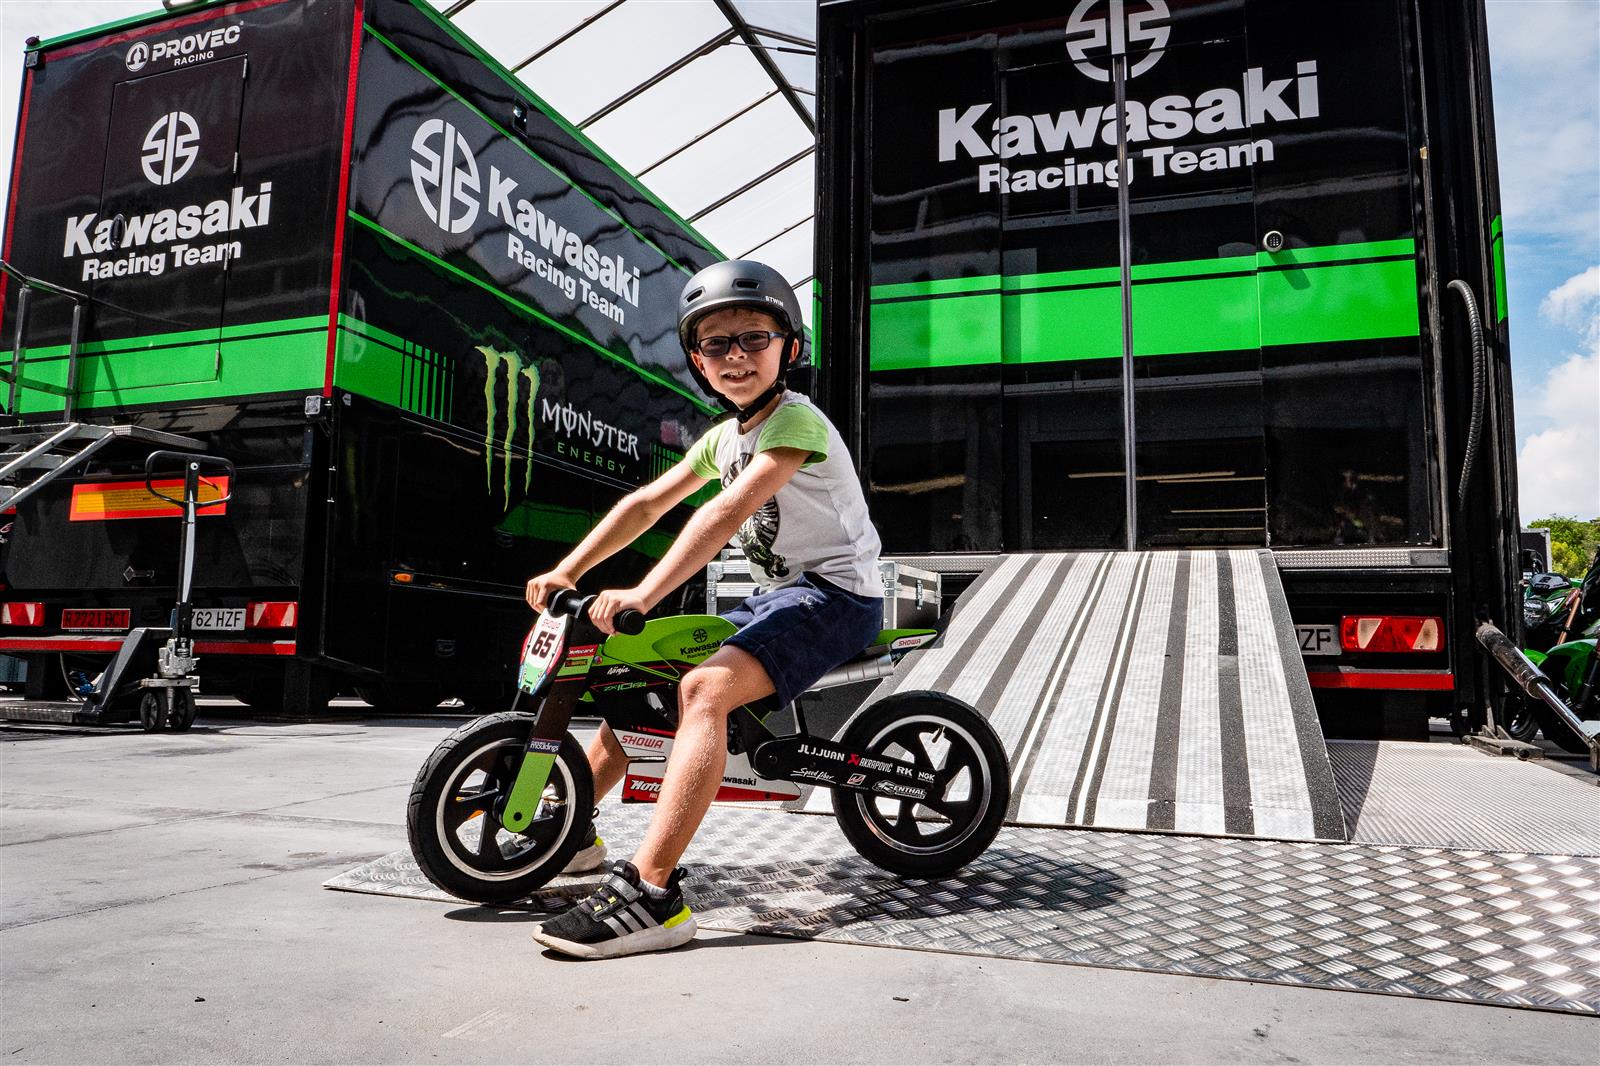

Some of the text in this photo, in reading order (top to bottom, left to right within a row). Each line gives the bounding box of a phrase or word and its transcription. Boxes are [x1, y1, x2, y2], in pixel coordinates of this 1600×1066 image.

[152, 25, 240, 61] PROVEC
[174, 50, 214, 66] RACING
[938, 60, 1320, 162] Kawasaki
[978, 139, 1275, 194] Racing Team
[63, 182, 272, 258] Kawasaki
[488, 165, 641, 308] Kawasaki
[82, 241, 242, 282] Racing Team
[507, 233, 624, 326] Racing Team
[542, 398, 640, 461] MONSTER
[557, 442, 626, 474] ENERGY
[192, 611, 242, 627] 62 HZF
[531, 630, 557, 659] 65
[621, 735, 664, 749] SHOWA
[722, 776, 757, 786] wasaki
[896, 766, 913, 776] RK
[918, 771, 935, 781] NGK
